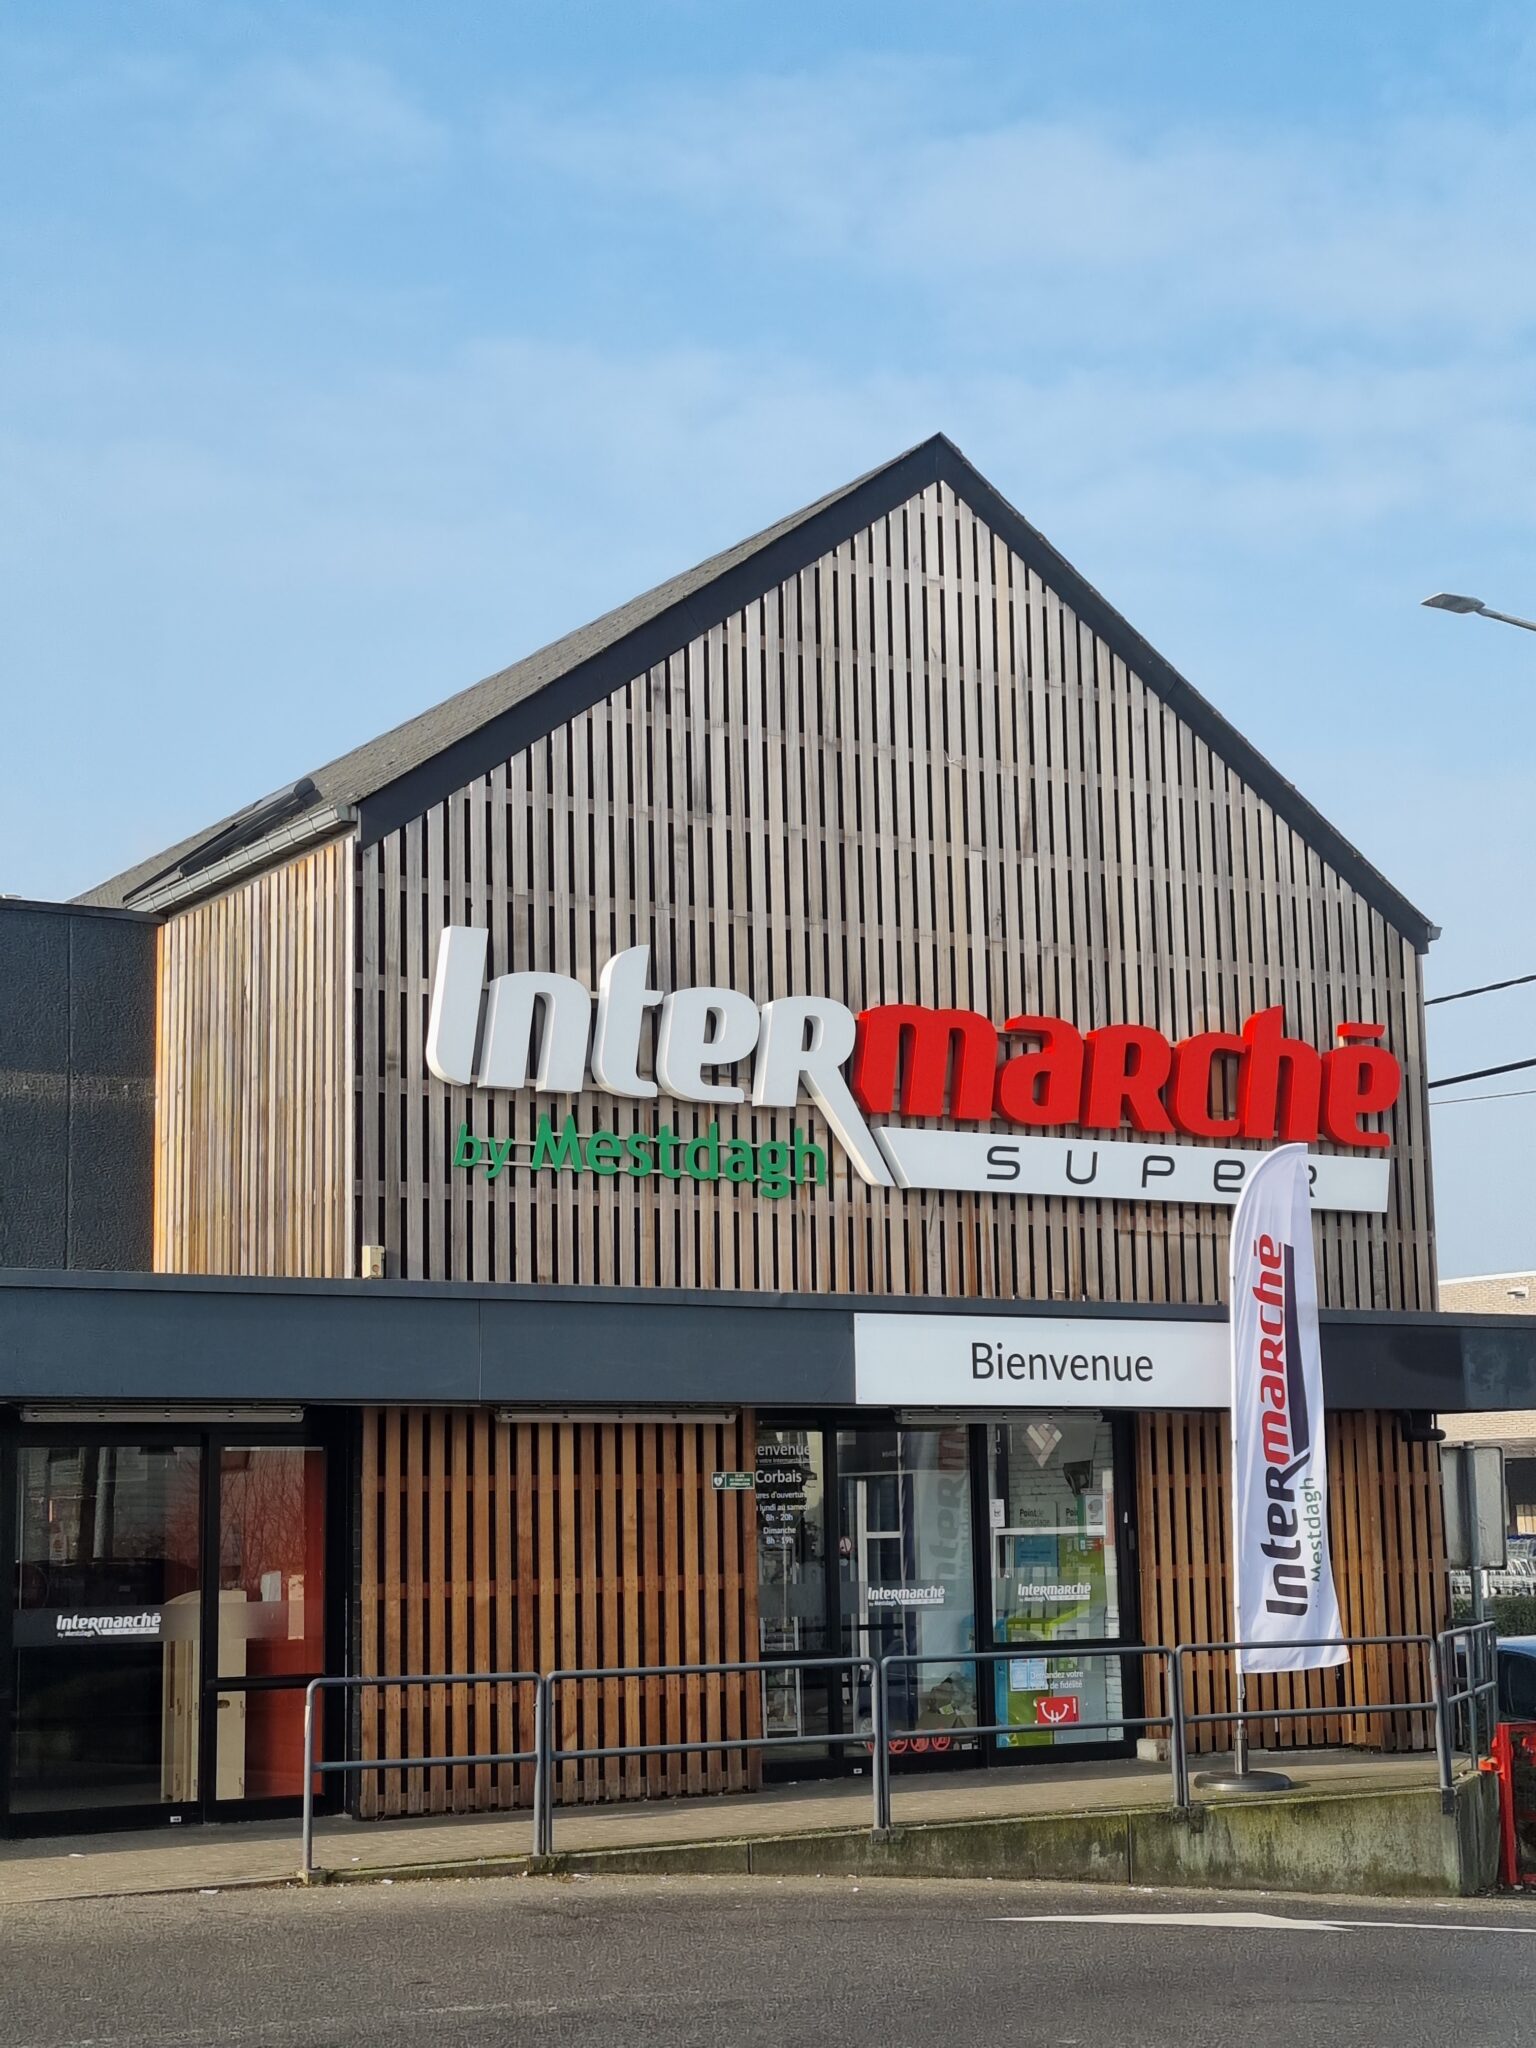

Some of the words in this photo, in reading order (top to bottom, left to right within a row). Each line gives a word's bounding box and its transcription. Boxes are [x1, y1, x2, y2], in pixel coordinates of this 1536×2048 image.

[453, 1123, 514, 1180] by
[531, 1112, 827, 1199] Mestdagh
[971, 1342, 1154, 1383] Bienvenue
[757, 1444, 811, 1456] envenue
[756, 1469, 802, 1483] Corbais
[763, 1526, 796, 1534] Dimanche
[1299, 1477, 1322, 1582] Mestdagh
